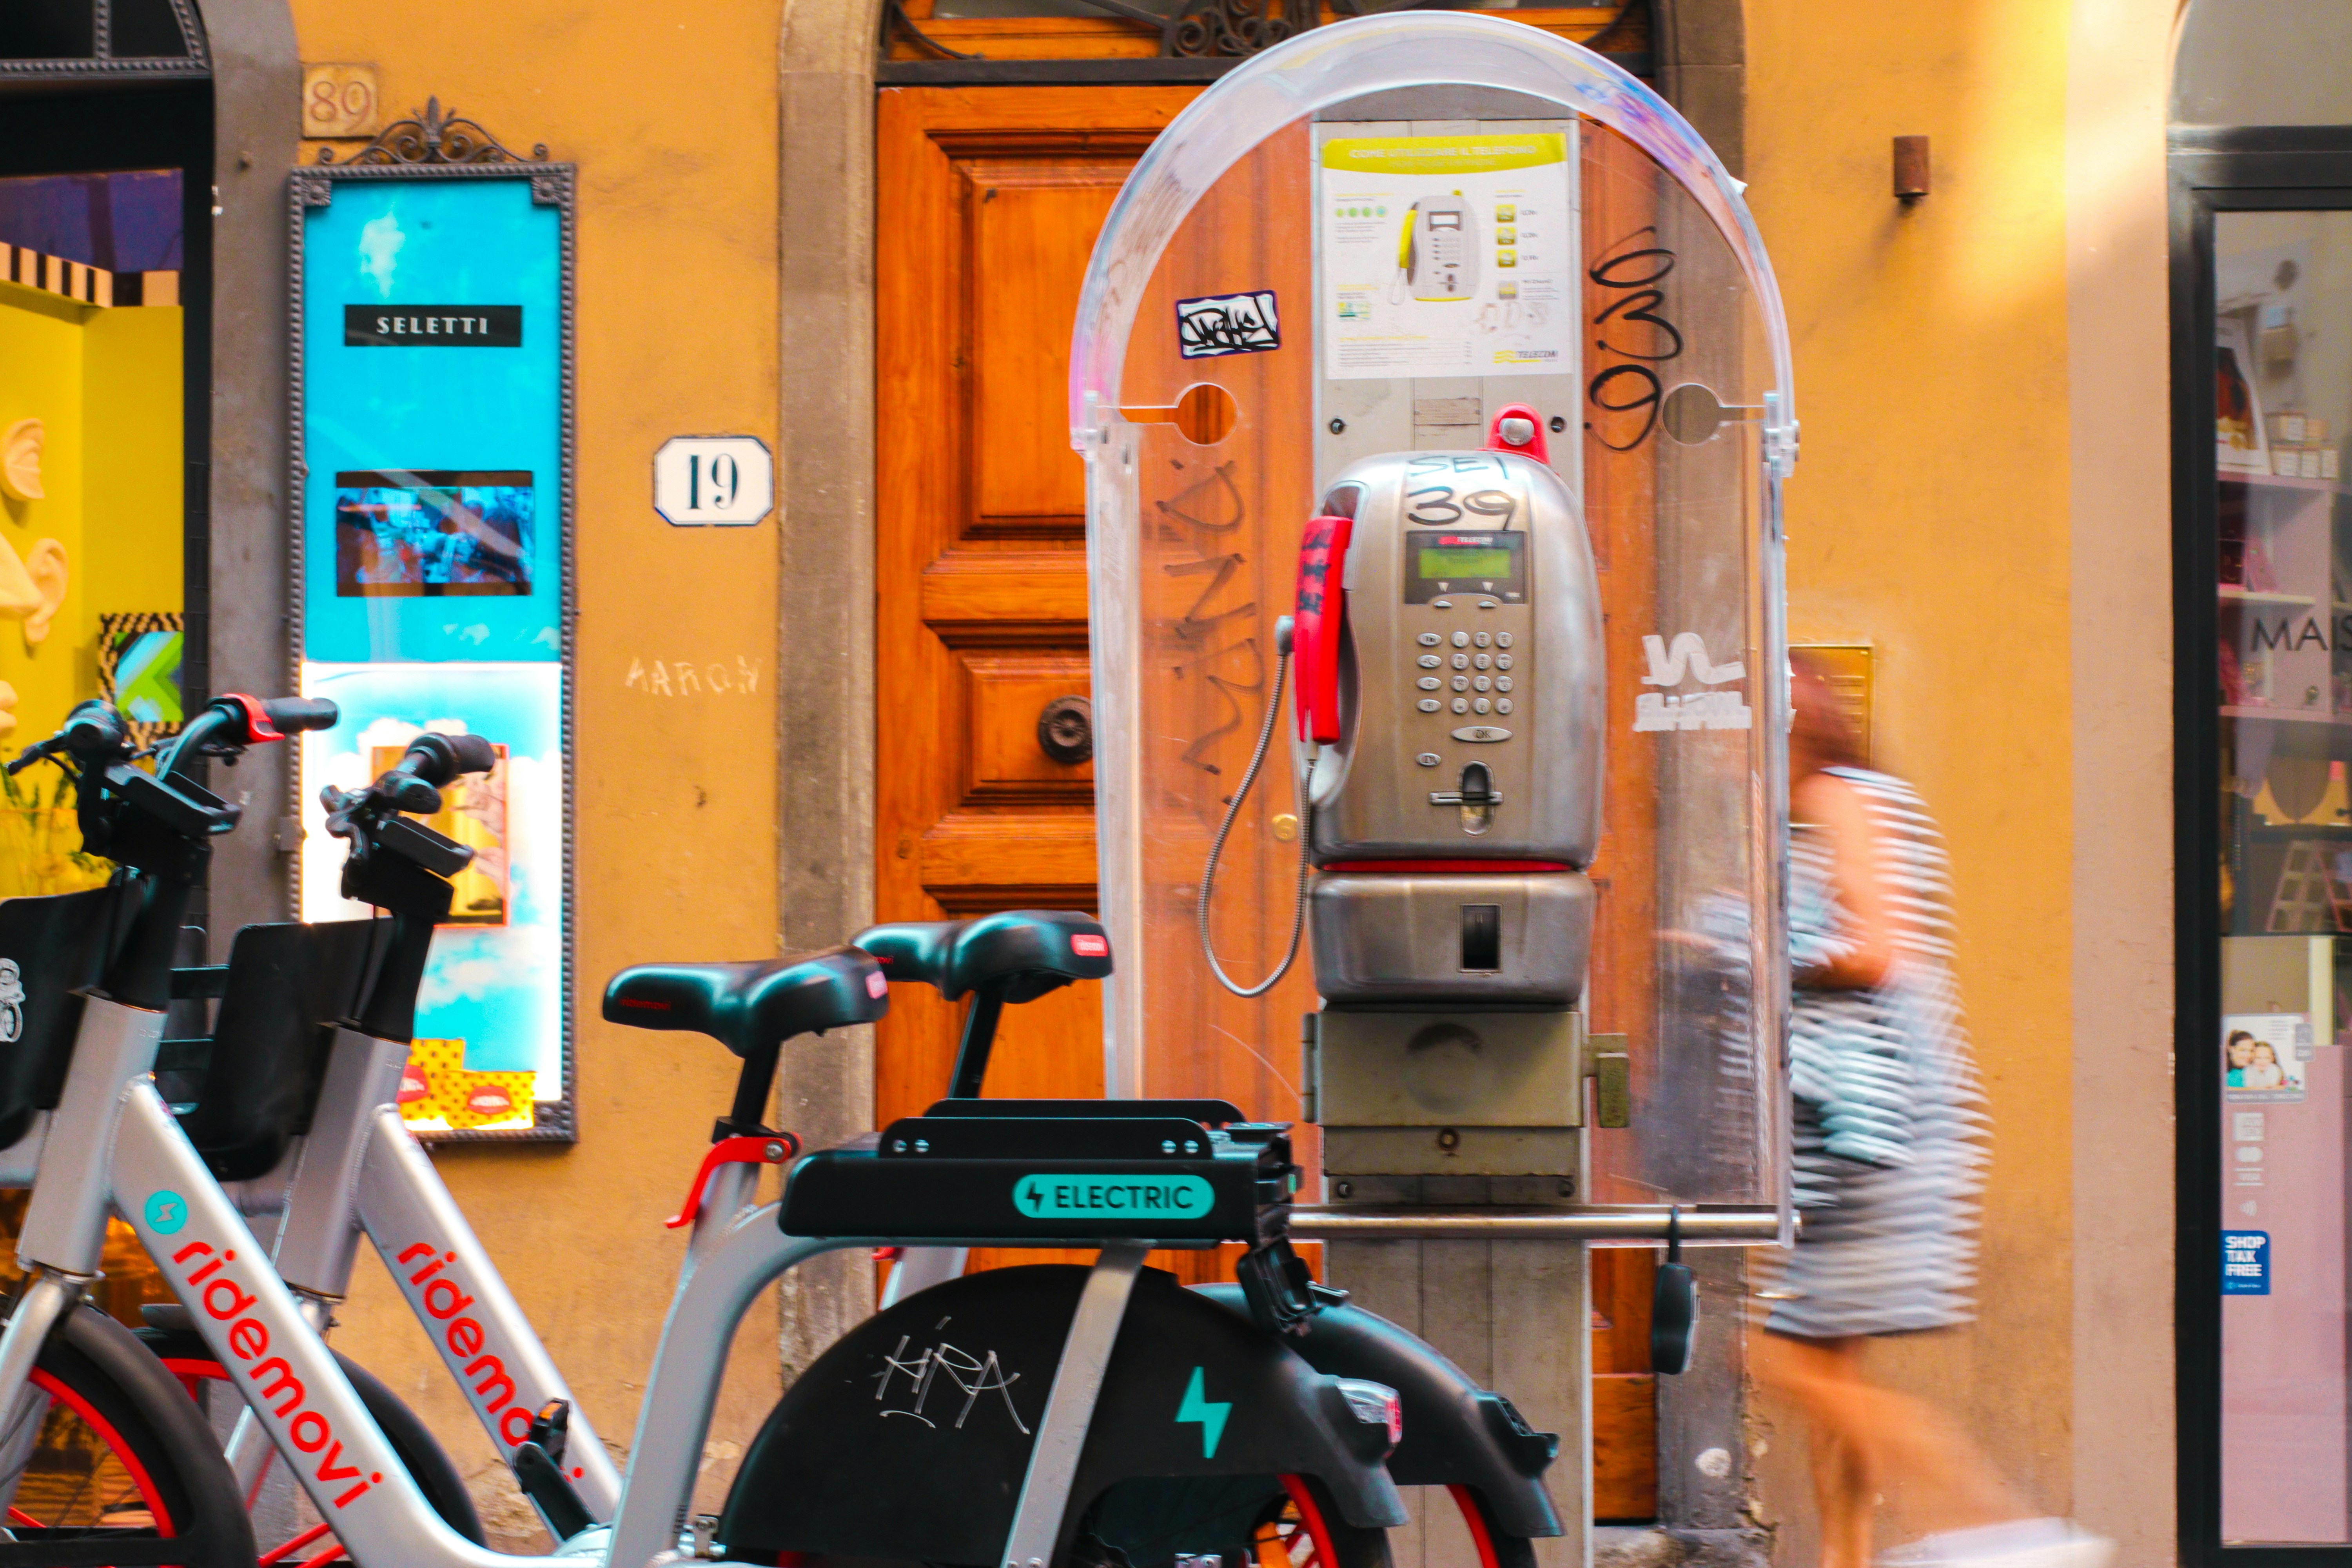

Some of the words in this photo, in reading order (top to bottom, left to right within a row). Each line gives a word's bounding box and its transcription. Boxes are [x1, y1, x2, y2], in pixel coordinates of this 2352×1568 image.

[376, 317, 488, 334] SELETTI
[688, 453, 738, 510] 19
[1406, 485, 1517, 530] 39
[1054, 1185, 1194, 1209] ELECTRIC
[2225, 1236, 2266, 1249] SHOP
[2225, 1250, 2257, 1263] TAX
[2225, 1263, 2263, 1277] FREE
[397, 1242, 585, 1483] ridemo
[172, 1241, 383, 1509] ridemovi
